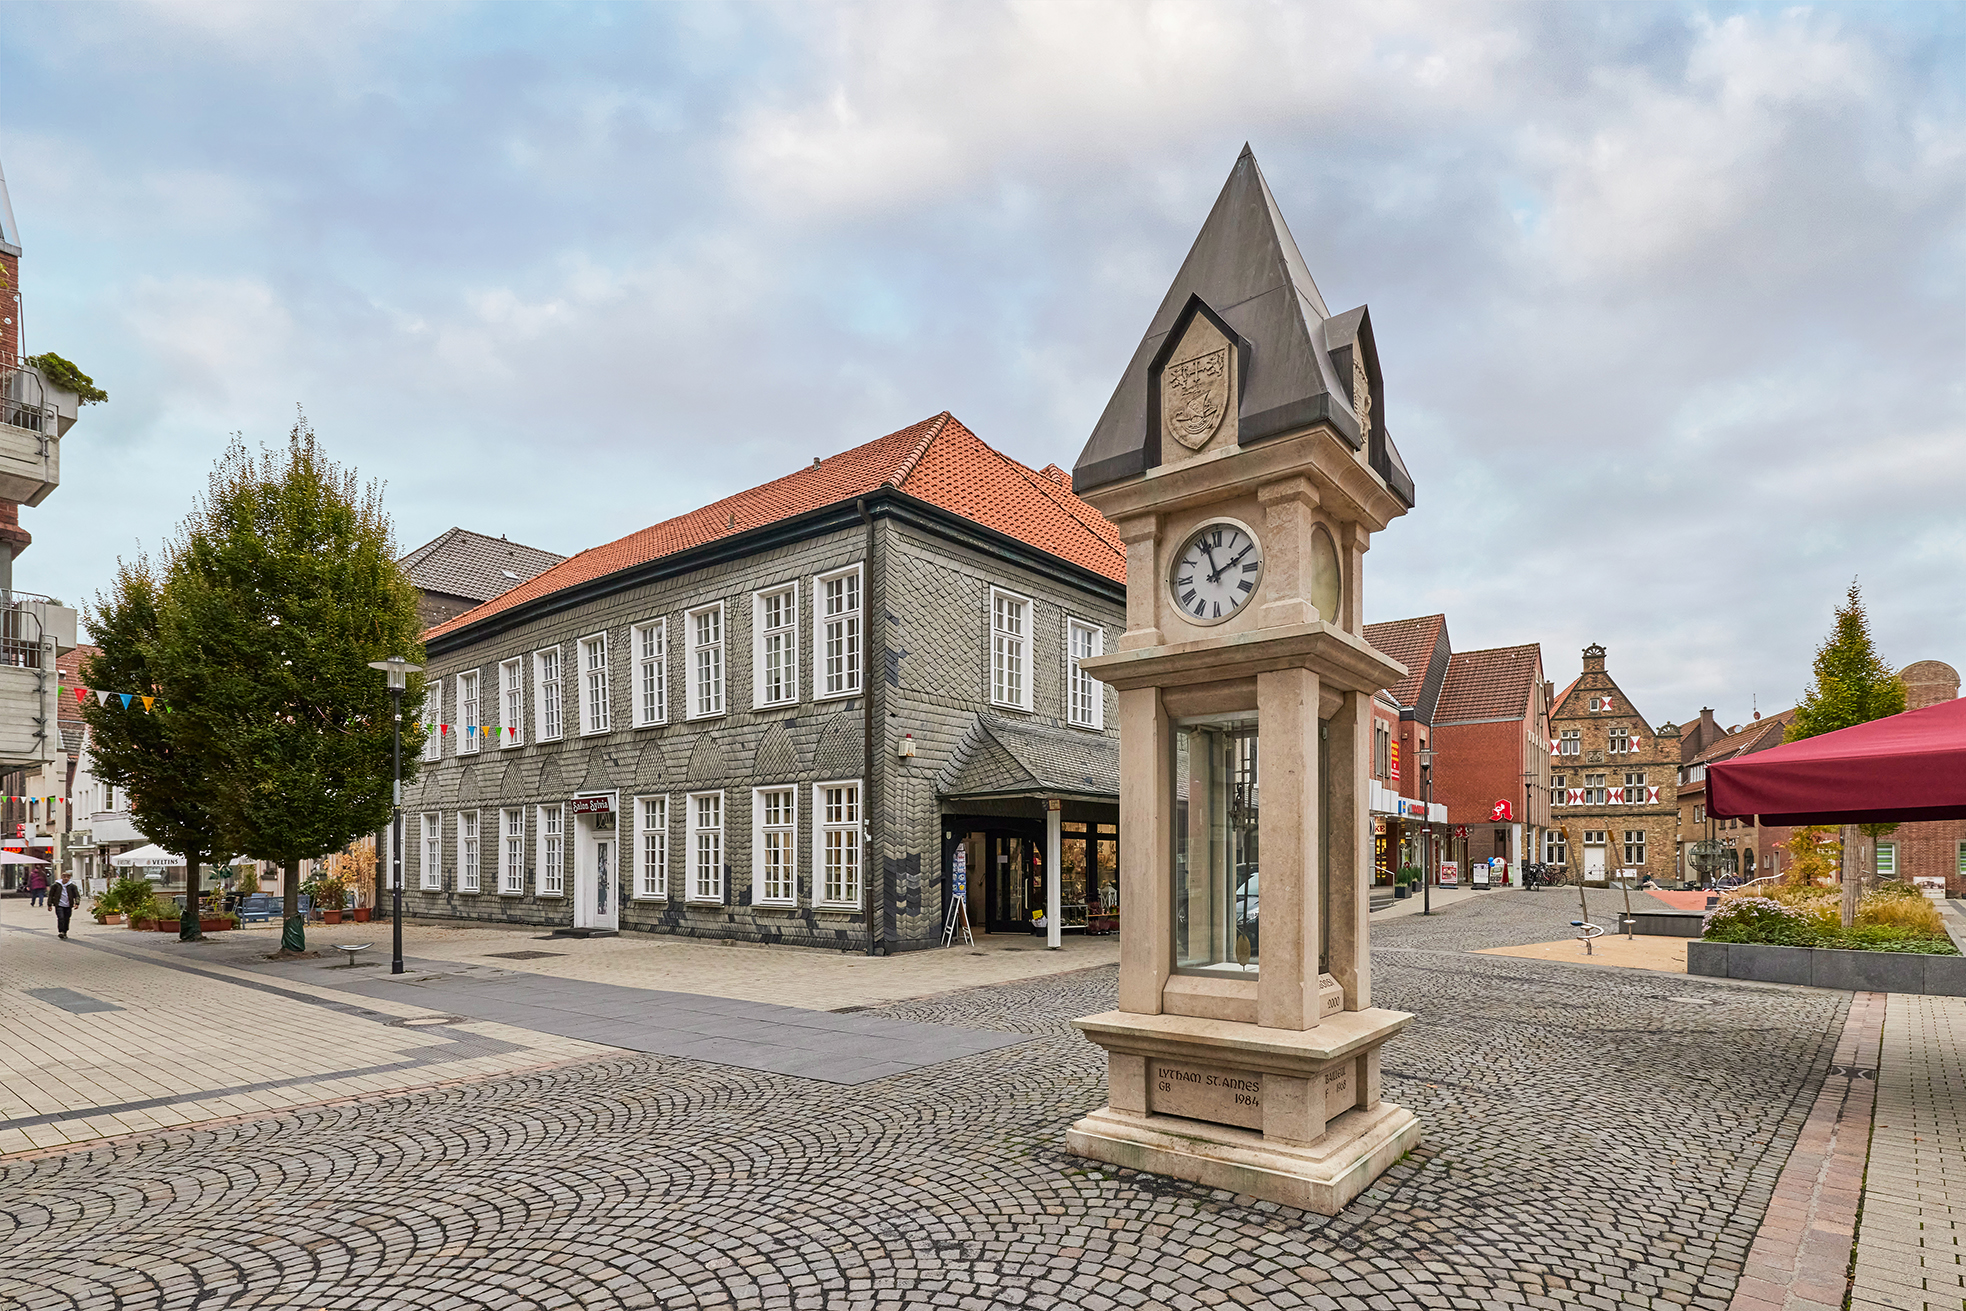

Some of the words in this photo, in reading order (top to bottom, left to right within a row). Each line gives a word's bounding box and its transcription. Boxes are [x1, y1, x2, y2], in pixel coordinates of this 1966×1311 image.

[1158, 1067, 1202, 1083] LYTHAM
[1158, 1081, 1171, 1092] GB
[1235, 1093, 1260, 1107] 1984
